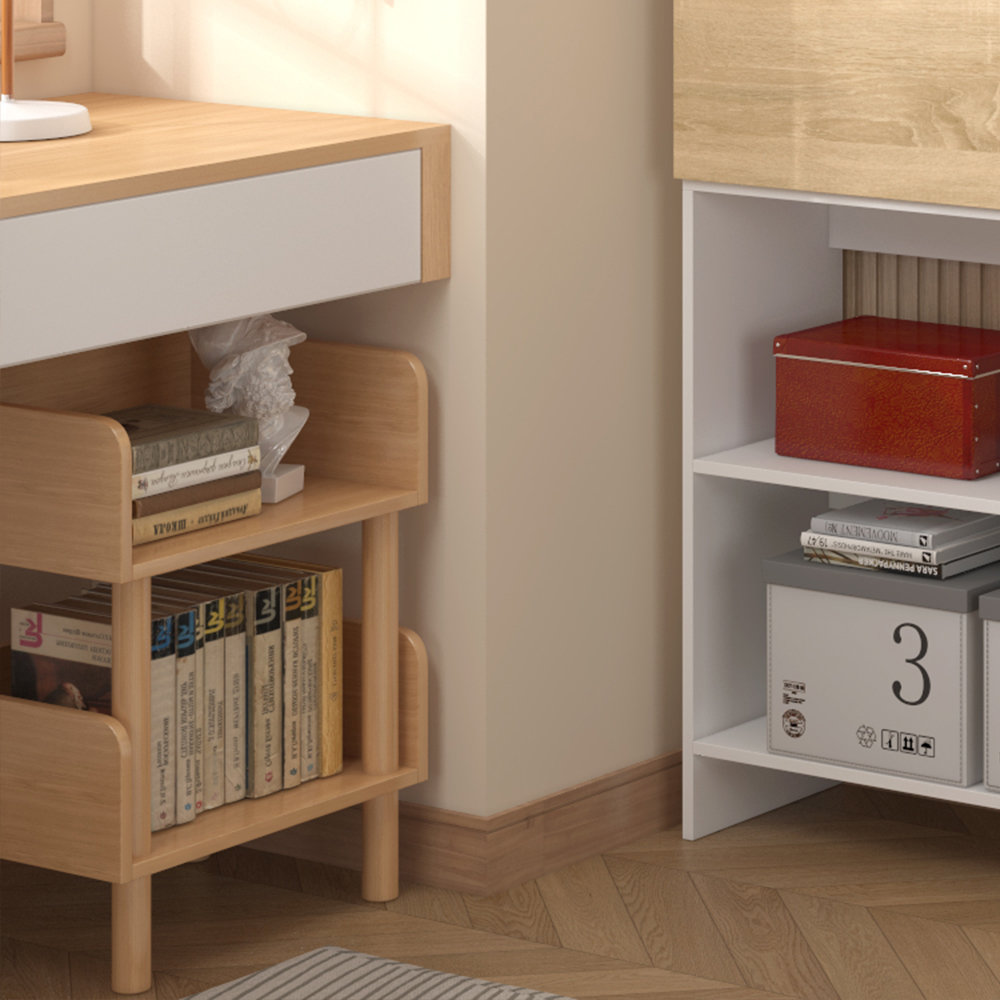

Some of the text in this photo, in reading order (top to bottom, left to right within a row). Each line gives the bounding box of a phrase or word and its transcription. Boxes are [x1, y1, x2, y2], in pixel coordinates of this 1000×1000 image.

[153, 519, 186, 535] ШКОЛА
[858, 556, 938, 576] SARA PENNYPACKER
[892, 622, 931, 706] 3
